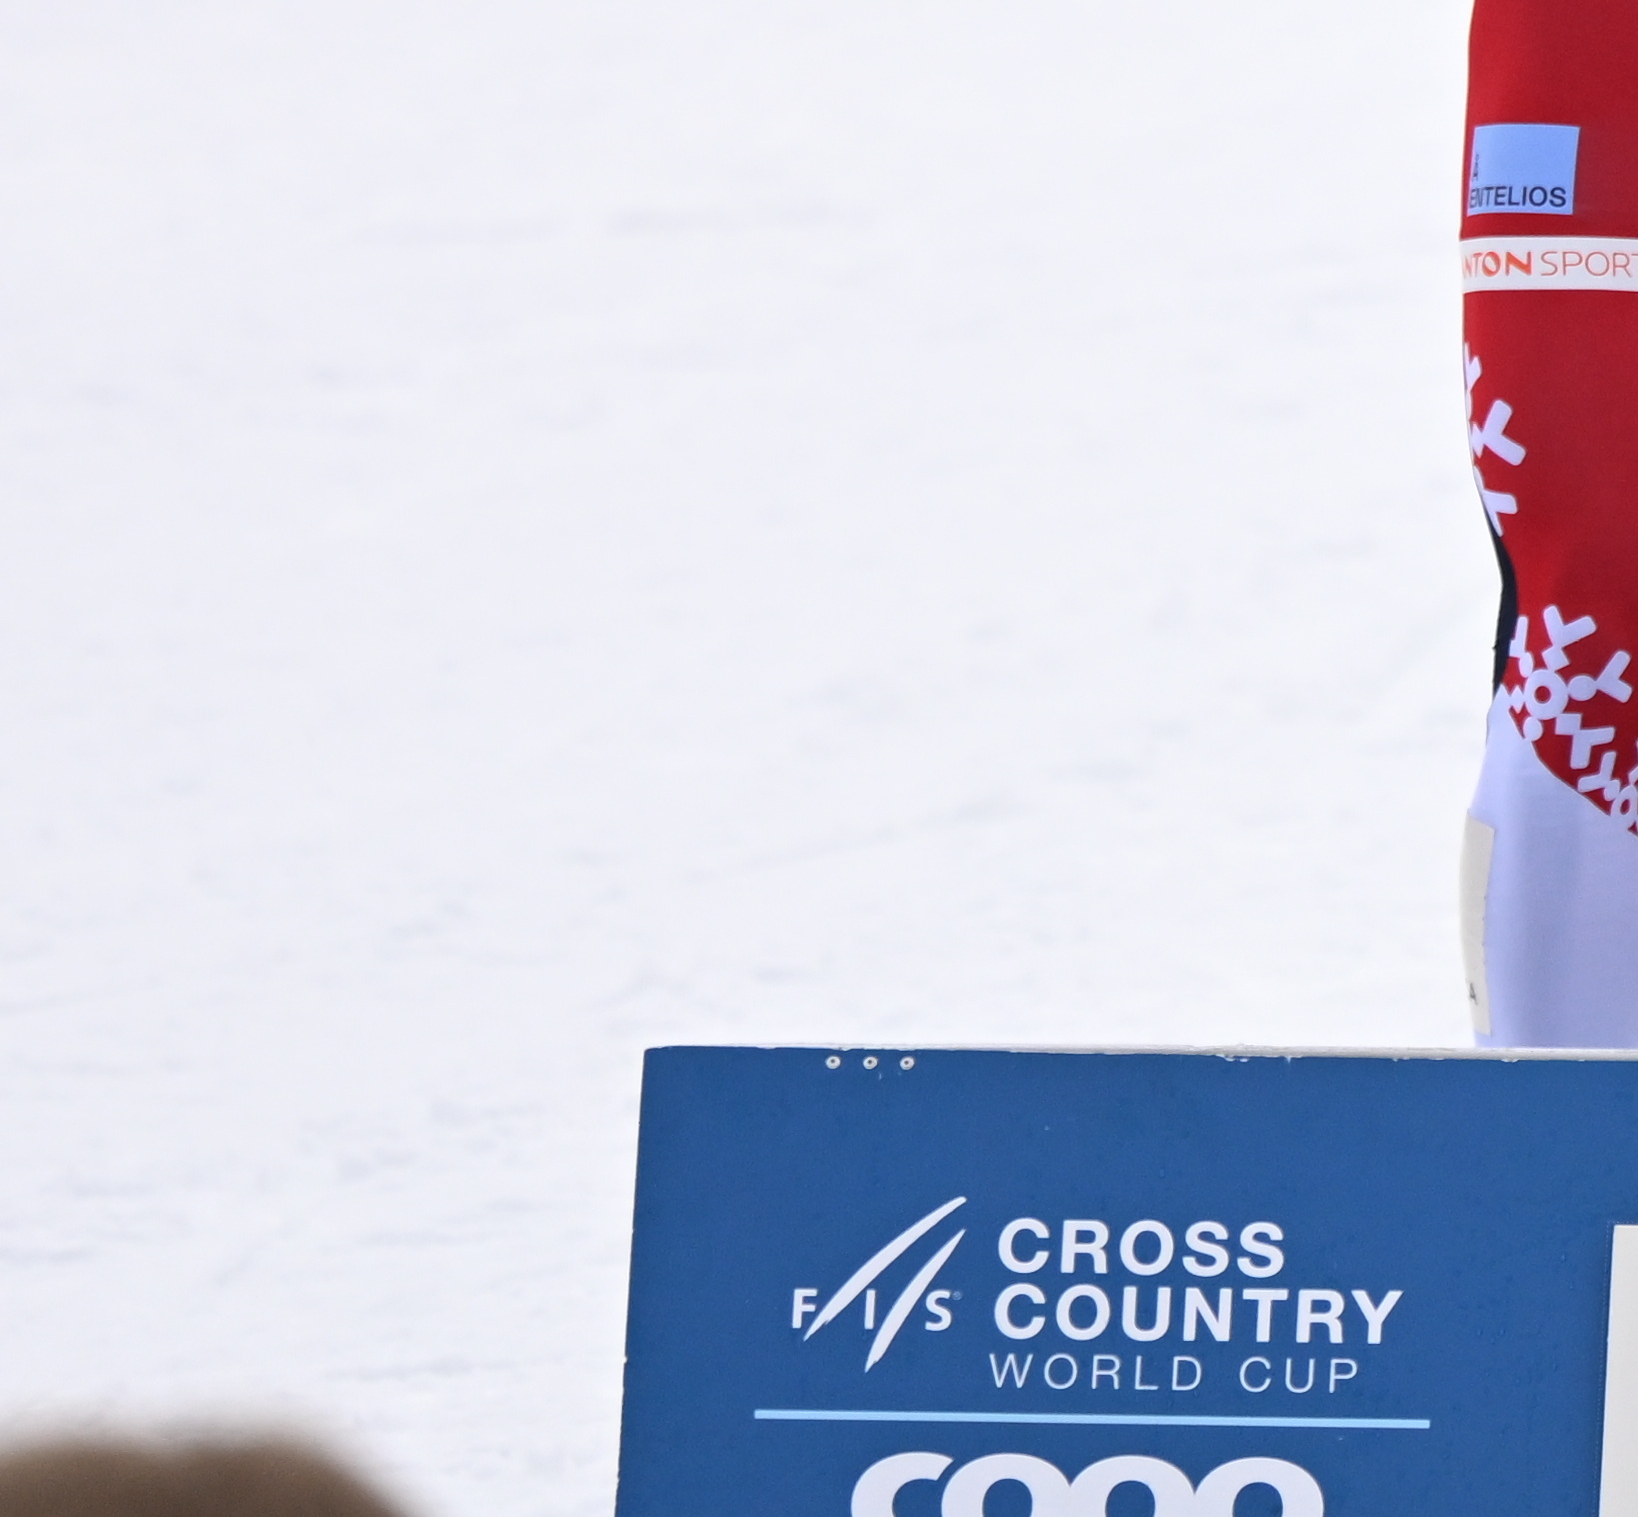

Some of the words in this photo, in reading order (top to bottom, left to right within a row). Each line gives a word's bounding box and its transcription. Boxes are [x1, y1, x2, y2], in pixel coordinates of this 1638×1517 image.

[1468, 185, 1567, 210] ENTELIOS
[1461, 249, 1533, 280] NTON
[999, 1218, 1285, 1277] CROSS
[791, 1288, 953, 1331] FIS
[995, 1283, 1402, 1344] COUNTRY
[988, 1353, 1202, 1392] WORLD
[1239, 1357, 1360, 1394] CUP
